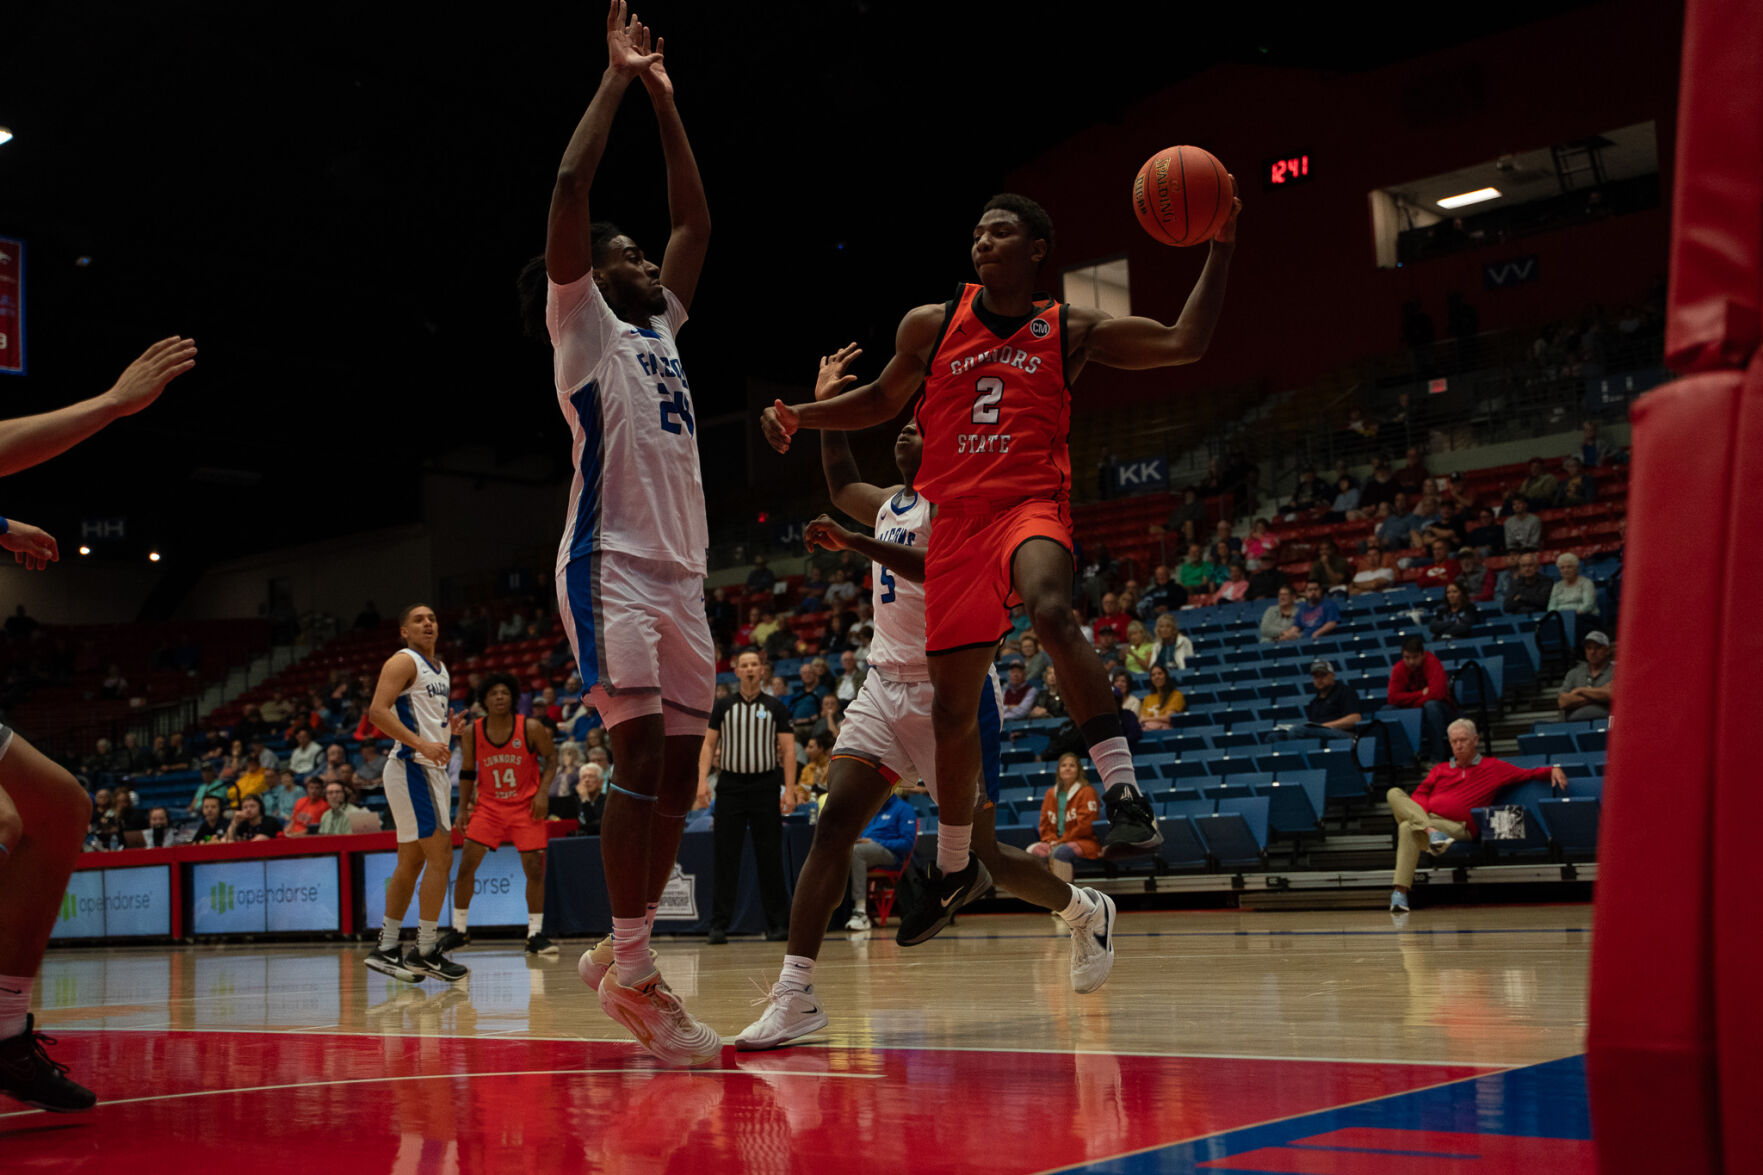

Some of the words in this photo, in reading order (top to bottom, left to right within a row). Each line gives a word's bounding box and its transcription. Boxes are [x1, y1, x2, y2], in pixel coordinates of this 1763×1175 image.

[1156, 157, 1175, 223] SPALDING
[1487, 259, 1533, 284] VV
[1033, 322, 1048, 334] CM
[950, 345, 1042, 375] CONNORS
[657, 382, 694, 439] 24
[972, 376, 1005, 424] 2
[957, 434, 1012, 453] STATE
[1119, 460, 1162, 486] KK
[81, 520, 125, 539] HH
[492, 768, 517, 789] 14
[1047, 807, 1077, 825] TEAS
[237, 882, 319, 909] opendorse
